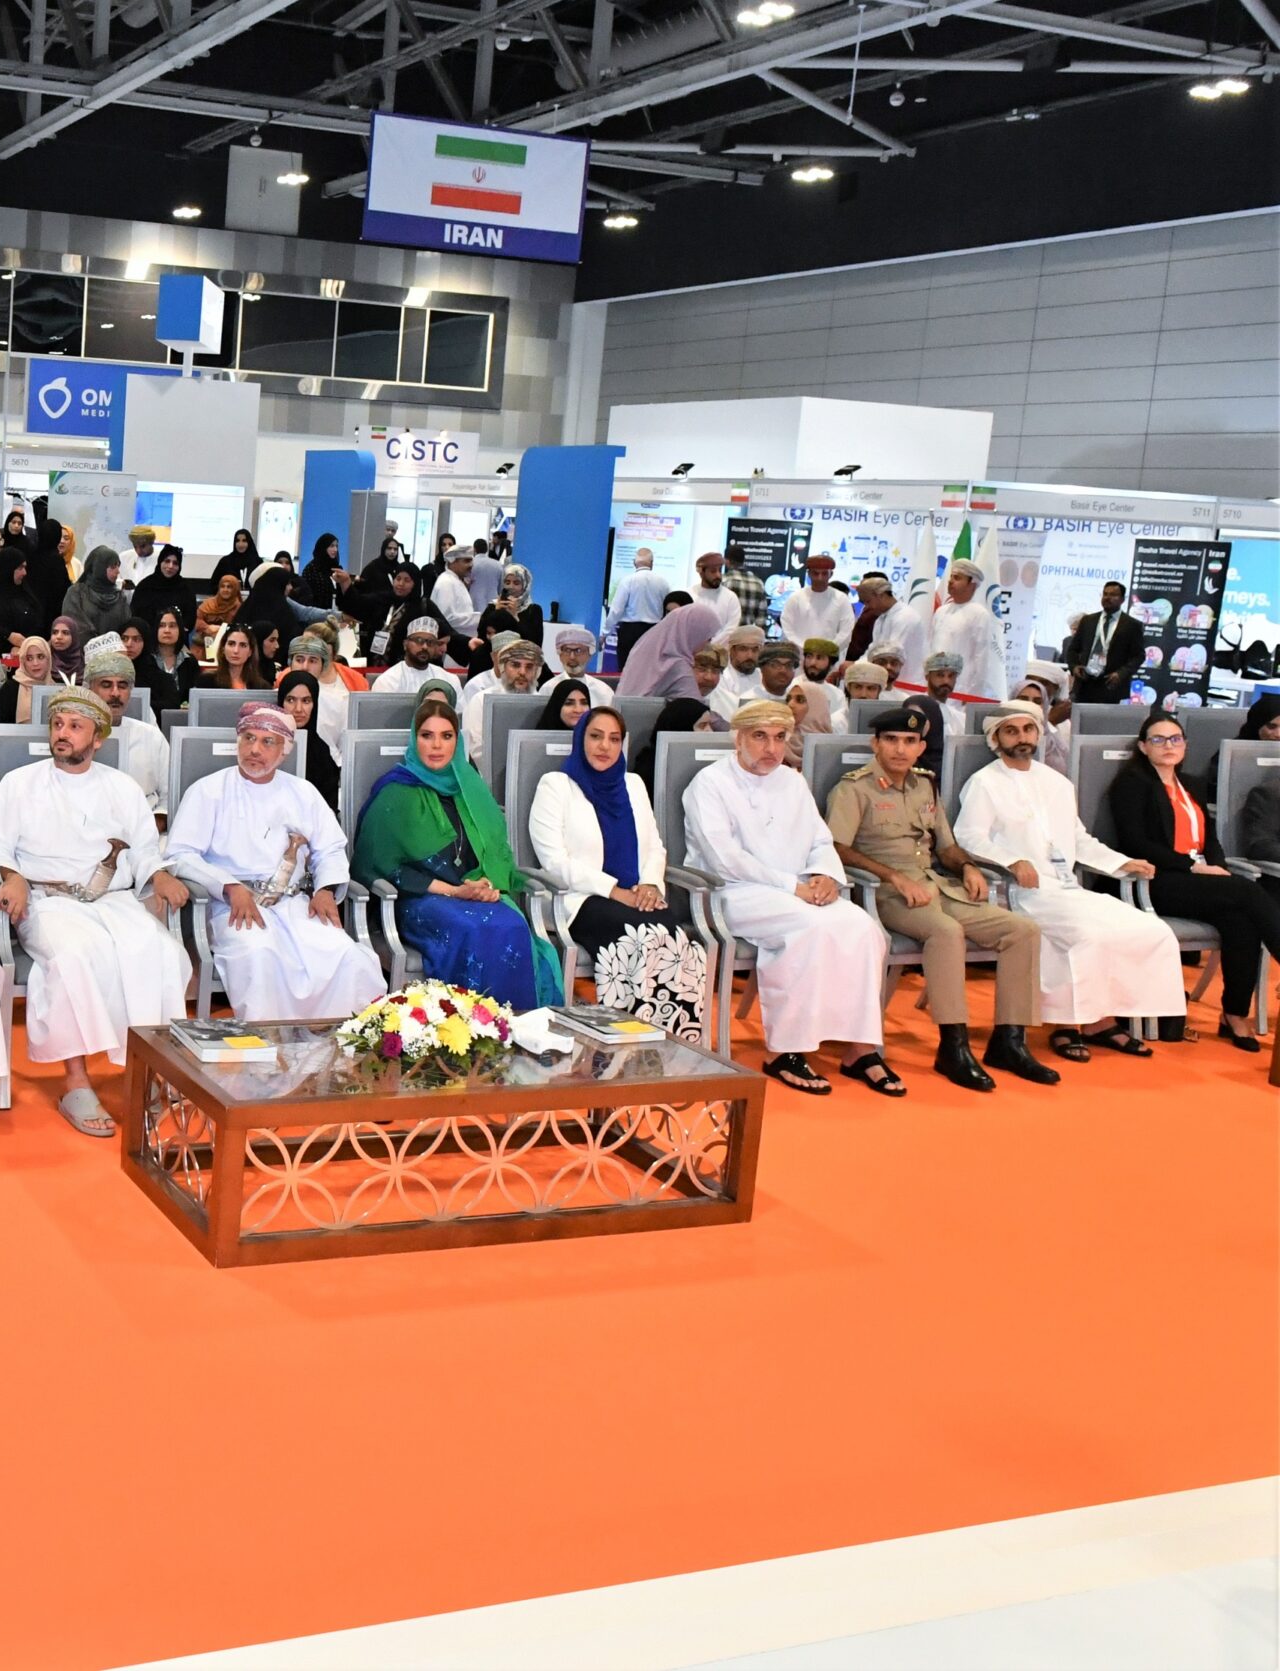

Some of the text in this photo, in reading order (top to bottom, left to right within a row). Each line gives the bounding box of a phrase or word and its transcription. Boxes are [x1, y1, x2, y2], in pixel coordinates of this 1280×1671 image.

[443, 223, 504, 249] IRAN
[81, 388, 113, 408] OM
[81, 408, 111, 418] MEDI
[1070, 499, 1135, 513] Basir Eye Center
[1192, 506, 1211, 518] 5711
[1223, 508, 1242, 519] 5710
[822, 508, 868, 523] BASIR
[873, 511, 900, 527] Eye
[1043, 517, 1182, 538] BASIR Eye Center
[1041, 564, 1127, 580] OPHTHALMOLOGY
